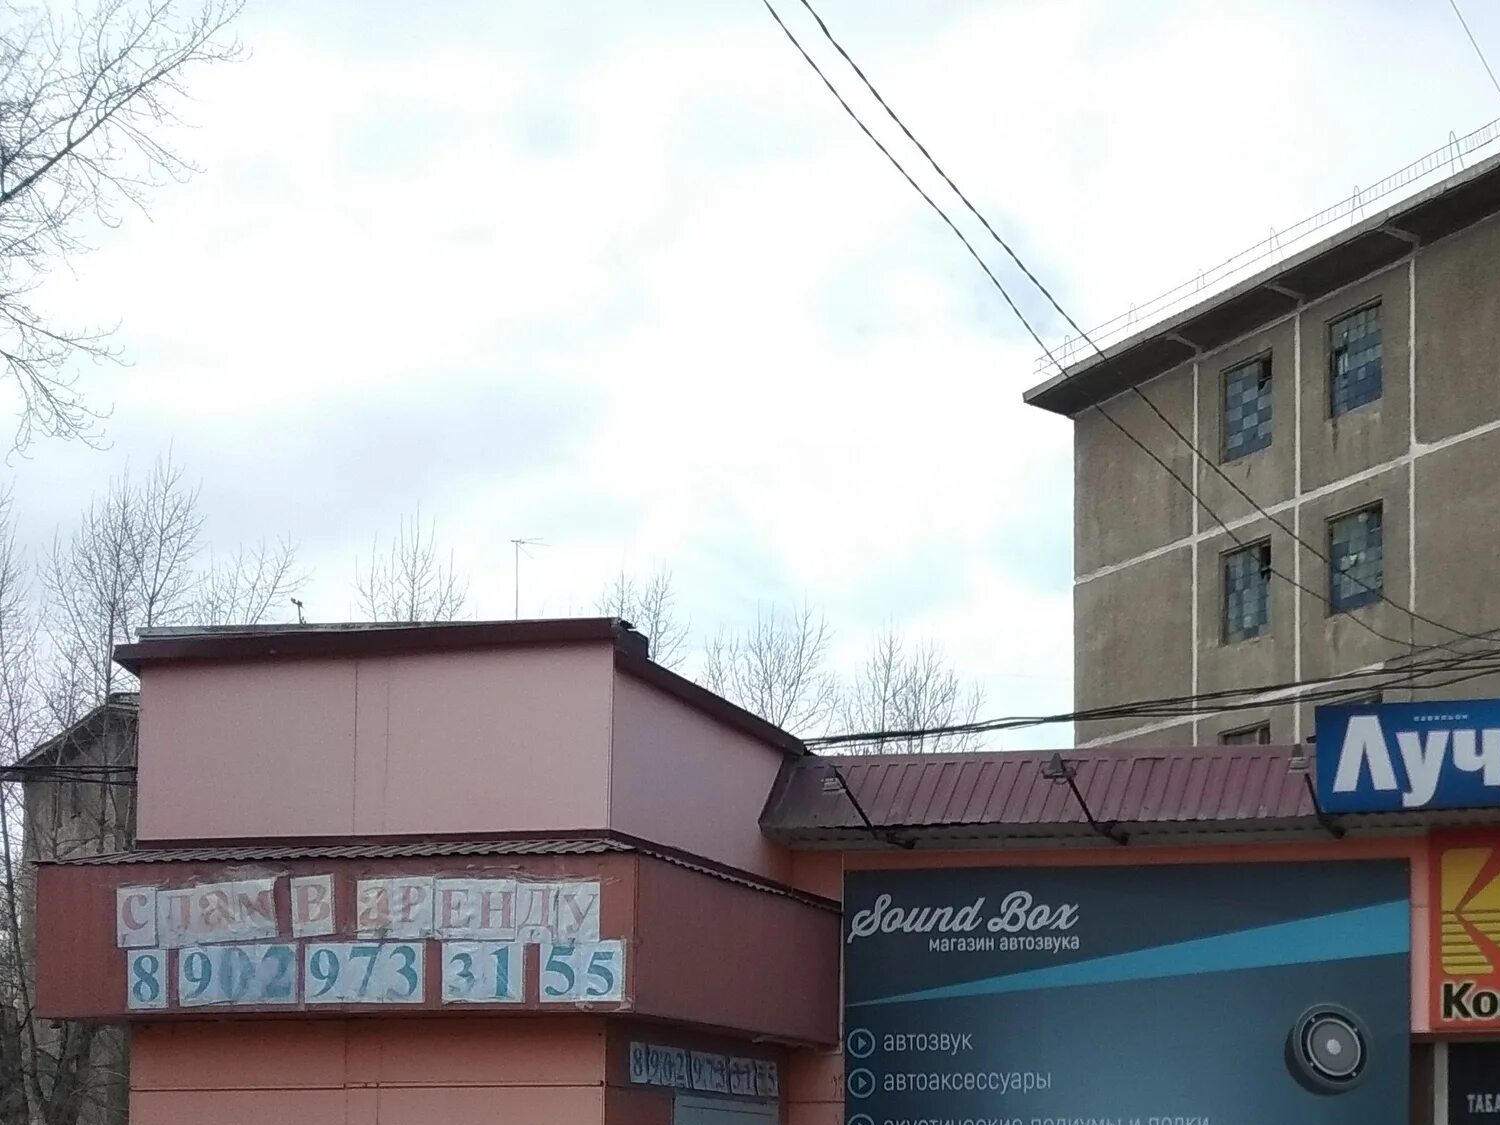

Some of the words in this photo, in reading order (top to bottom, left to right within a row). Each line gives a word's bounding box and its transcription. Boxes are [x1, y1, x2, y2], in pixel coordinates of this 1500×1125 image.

[847, 893, 986, 943] Sound
[987, 890, 1080, 933] Box
[929, 937, 994, 951] магазин
[999, 936, 1080, 953] автозвука
[132, 954, 160, 1002] 8
[310, 945, 420, 998] 973
[544, 945, 616, 996] 55
[883, 1031, 973, 1054] автозвук
[883, 1070, 1051, 1094] автоаксессуары
